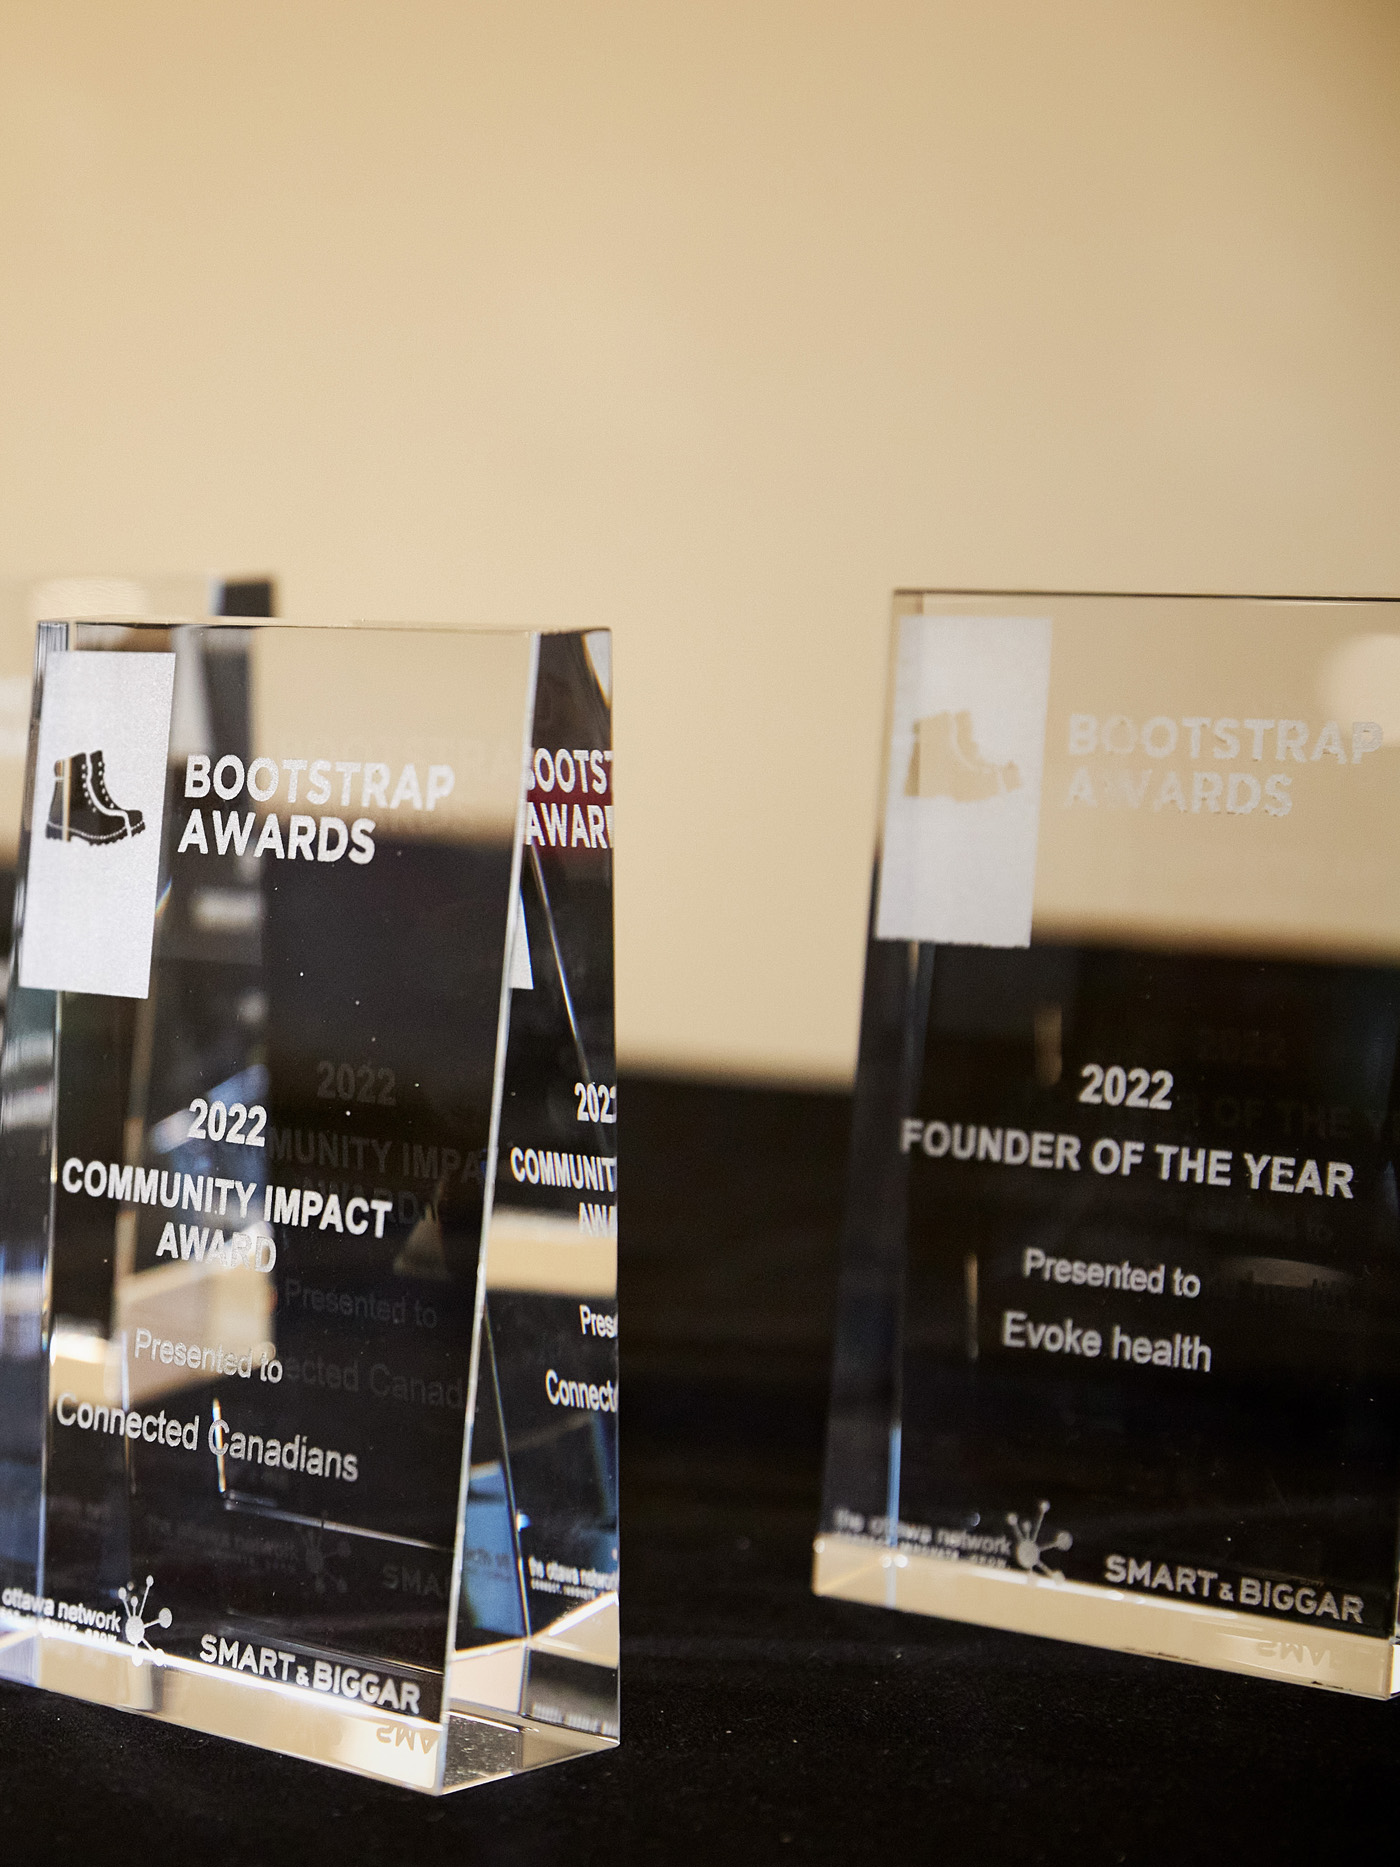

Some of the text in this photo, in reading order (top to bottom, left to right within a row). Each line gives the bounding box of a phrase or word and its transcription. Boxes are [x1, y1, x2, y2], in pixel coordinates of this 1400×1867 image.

[1067, 713, 1385, 765] BOOTSTRAP
[184, 753, 455, 812] BOOTSTRAP
[1062, 766, 1294, 818] AWARDS
[177, 808, 376, 865] AWARDS
[1078, 1063, 1175, 1111] 2022
[188, 1097, 268, 1148] 2022
[901, 1117, 1355, 1199] FOUNDER OF THE YEAR
[61, 1156, 257, 1220] COMMUNITY
[263, 1185, 393, 1240] IMPACT
[155, 1221, 277, 1273] AWARD
[1022, 1247, 1201, 1299] Presented to
[134, 1327, 284, 1384] Presented to
[1002, 1309, 1213, 1373] Evoke health
[56, 1392, 359, 1482] Connected Canadians
[58, 1601, 121, 1633] network
[1105, 1554, 1218, 1597] SMART
[1240, 1577, 1365, 1624] BIGGAR
[200, 1633, 296, 1682] SMART
[312, 1660, 421, 1715] BIGGAR
